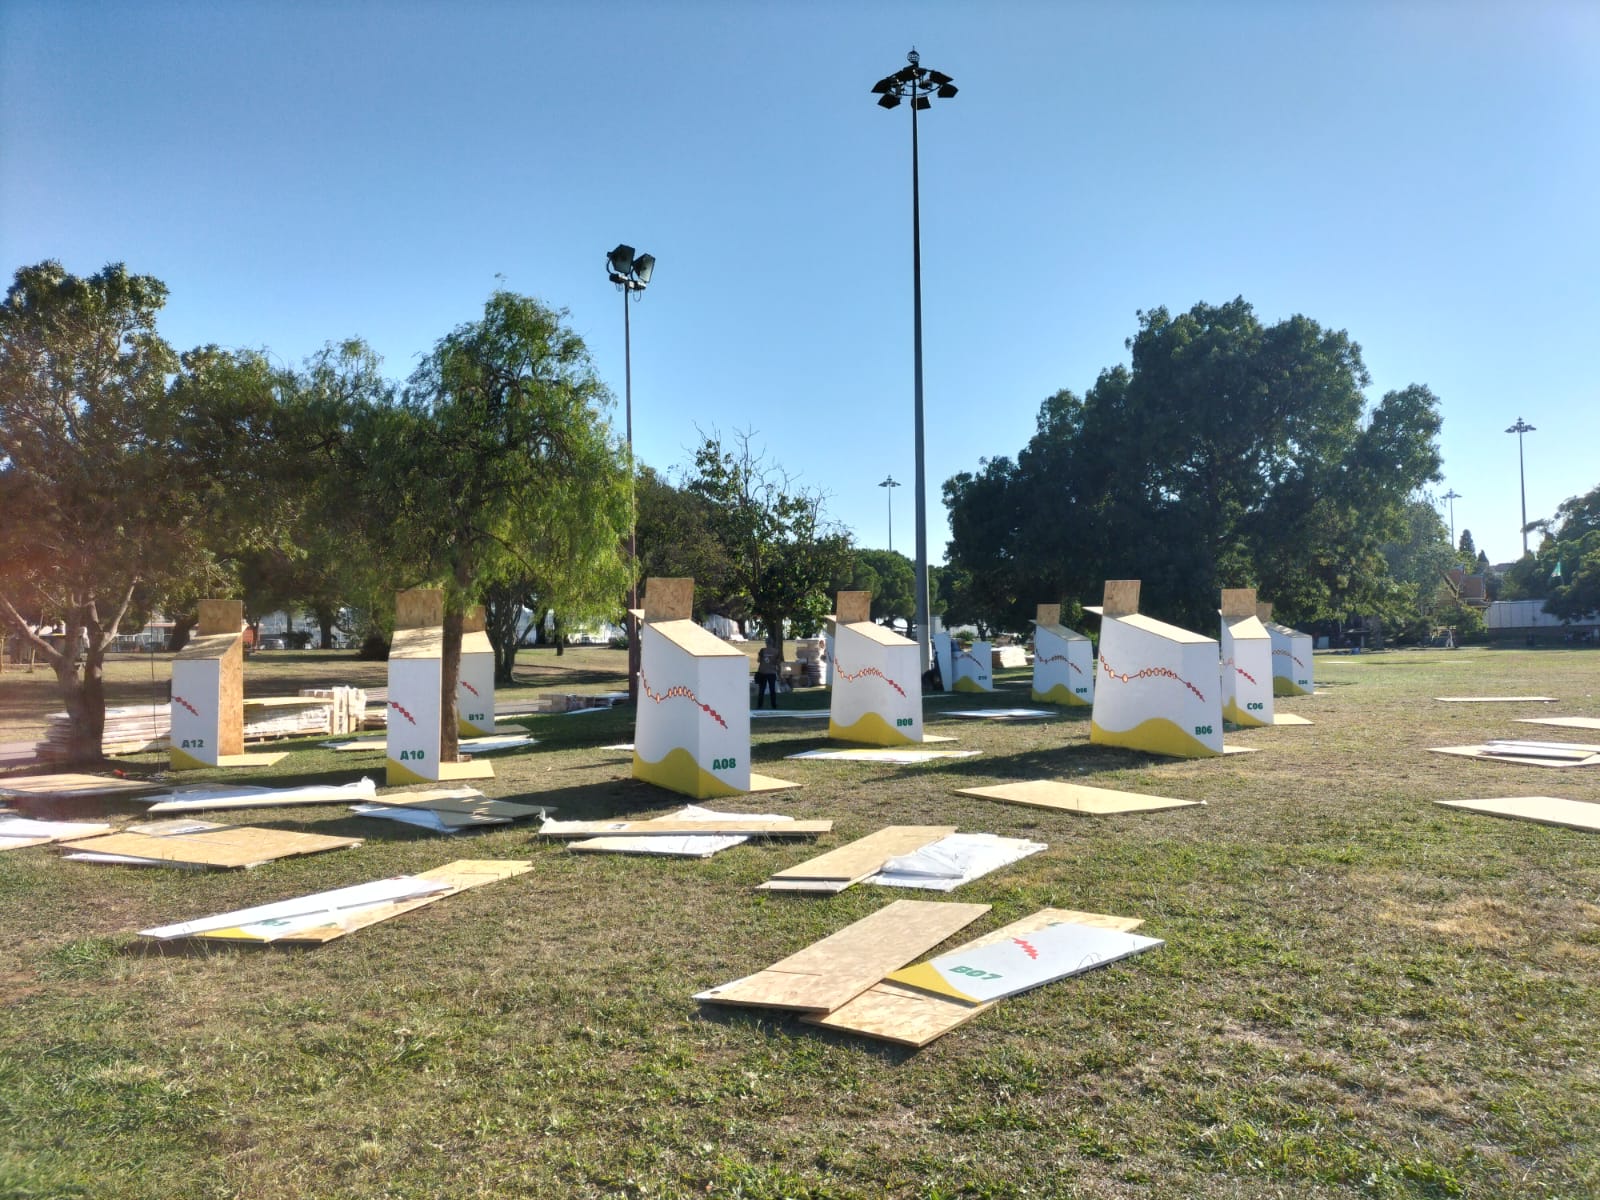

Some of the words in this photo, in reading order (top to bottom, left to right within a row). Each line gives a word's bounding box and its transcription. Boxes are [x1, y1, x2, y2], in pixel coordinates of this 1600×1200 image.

[1246, 702, 1264, 711] C06
[1195, 725, 1213, 736] B06
[181, 739, 205, 749] A12
[399, 750, 425, 761] A10
[712, 757, 737, 771] A08
[949, 965, 1003, 980] B07
